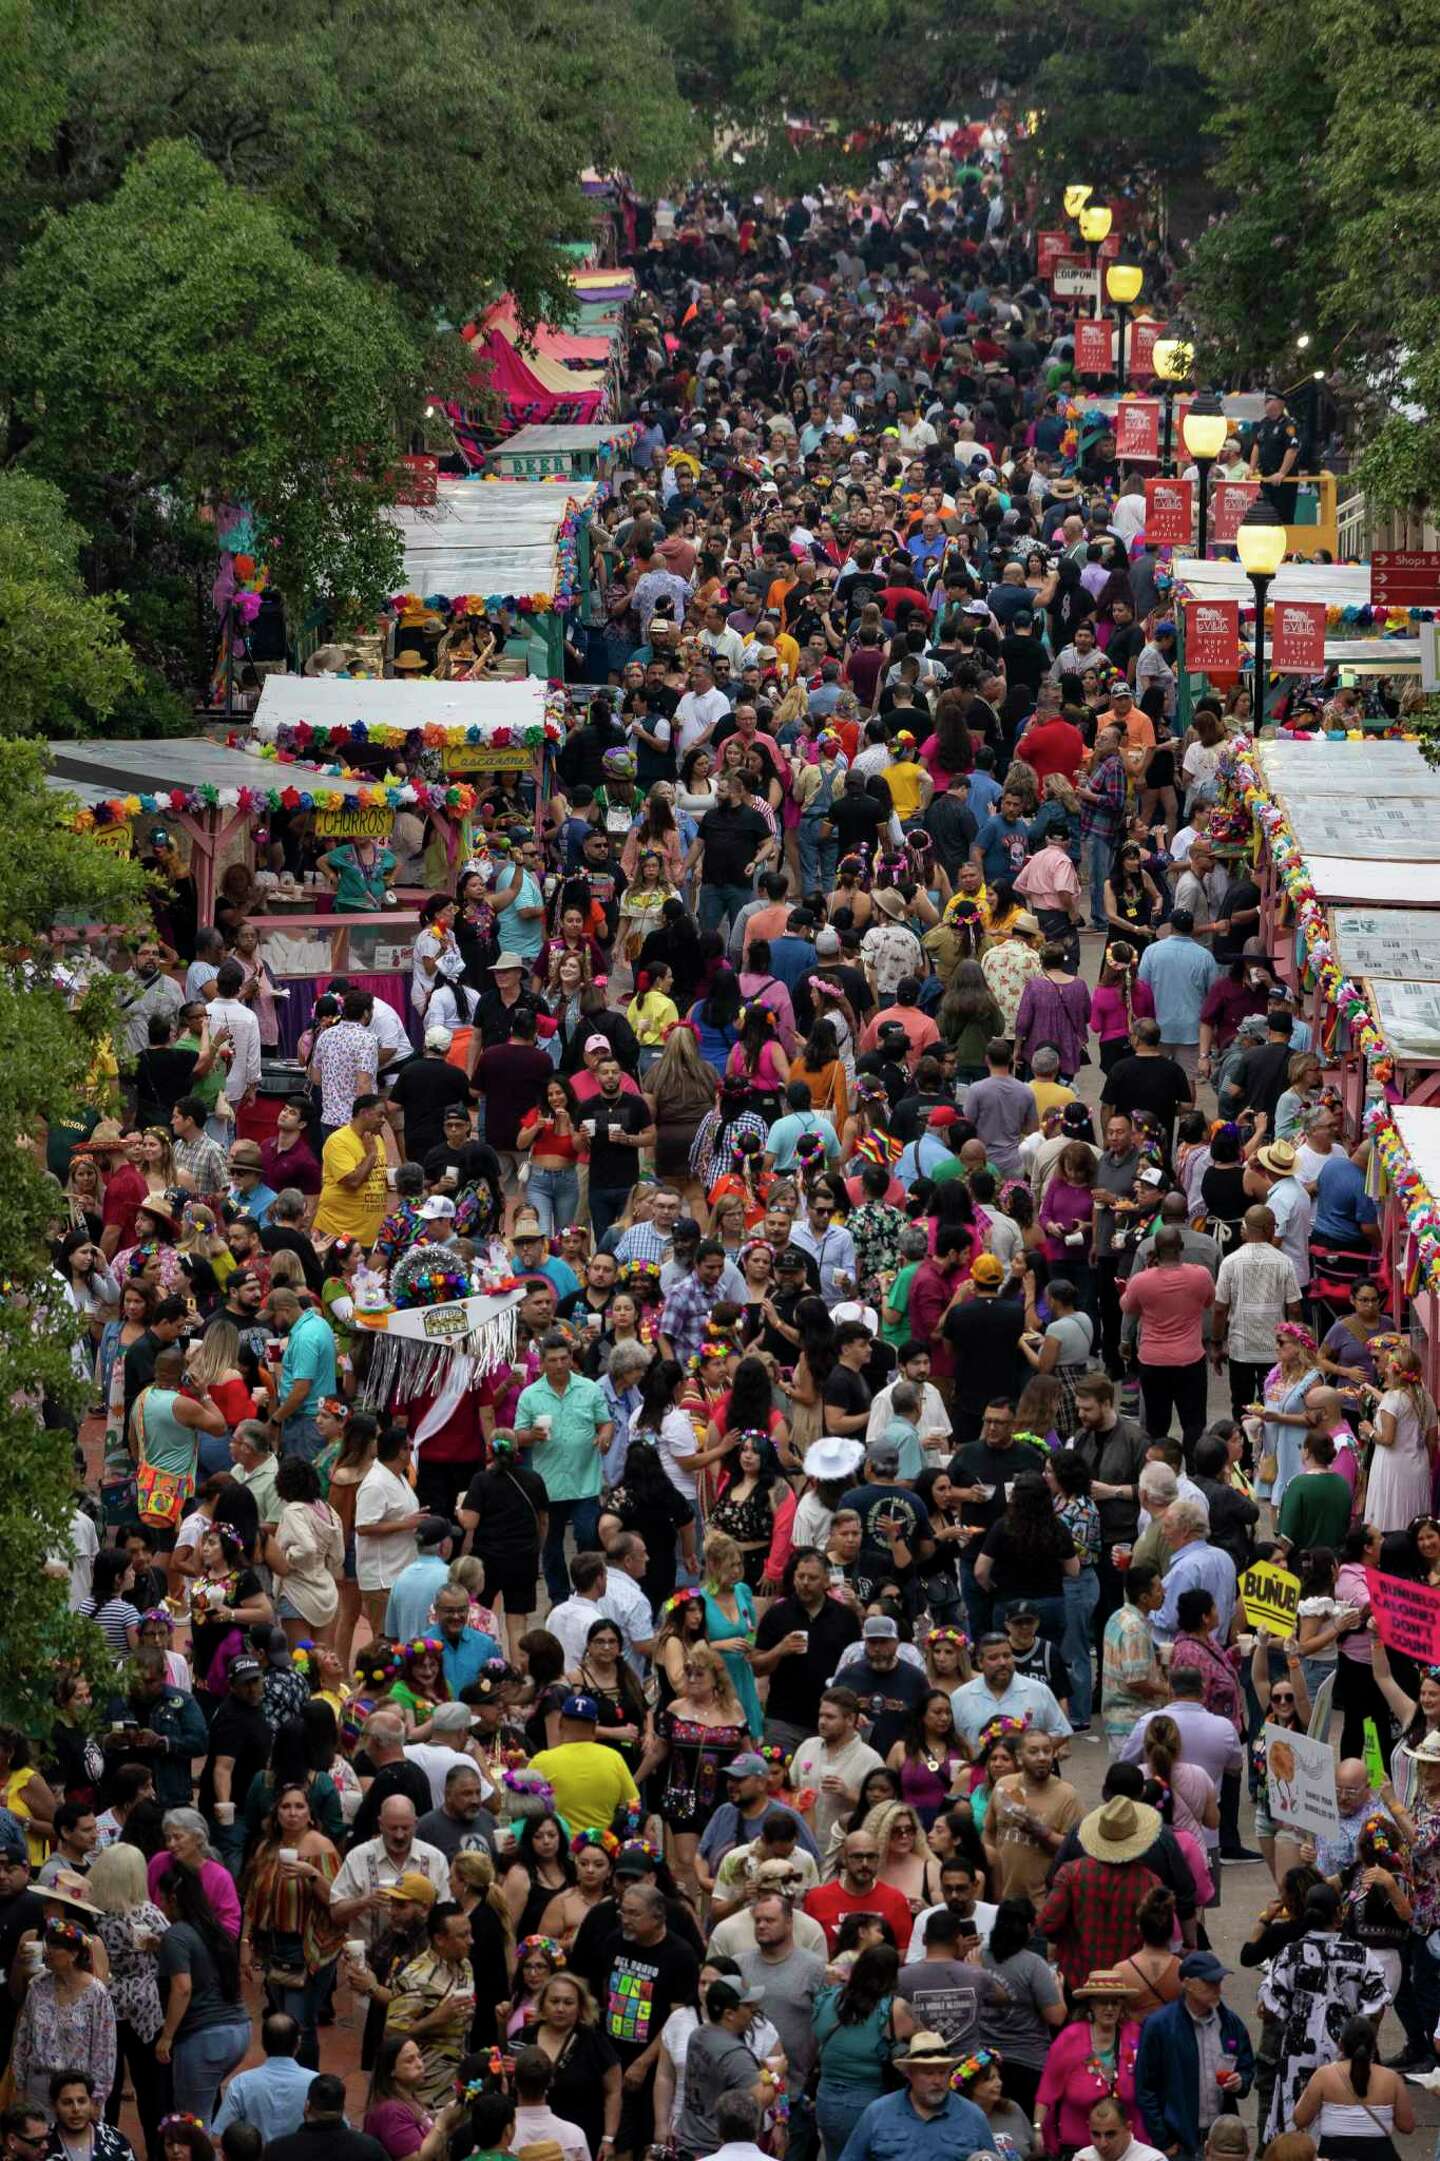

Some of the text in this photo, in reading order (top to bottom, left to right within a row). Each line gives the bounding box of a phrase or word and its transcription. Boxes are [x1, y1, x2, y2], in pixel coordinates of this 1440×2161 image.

[513, 457, 563, 474] BEER
[1395, 554, 1426, 568] Shops
[1194, 656, 1230, 665] Dining
[1280, 657, 1316, 667] Dining
[324, 809, 386, 834] CHURROS
